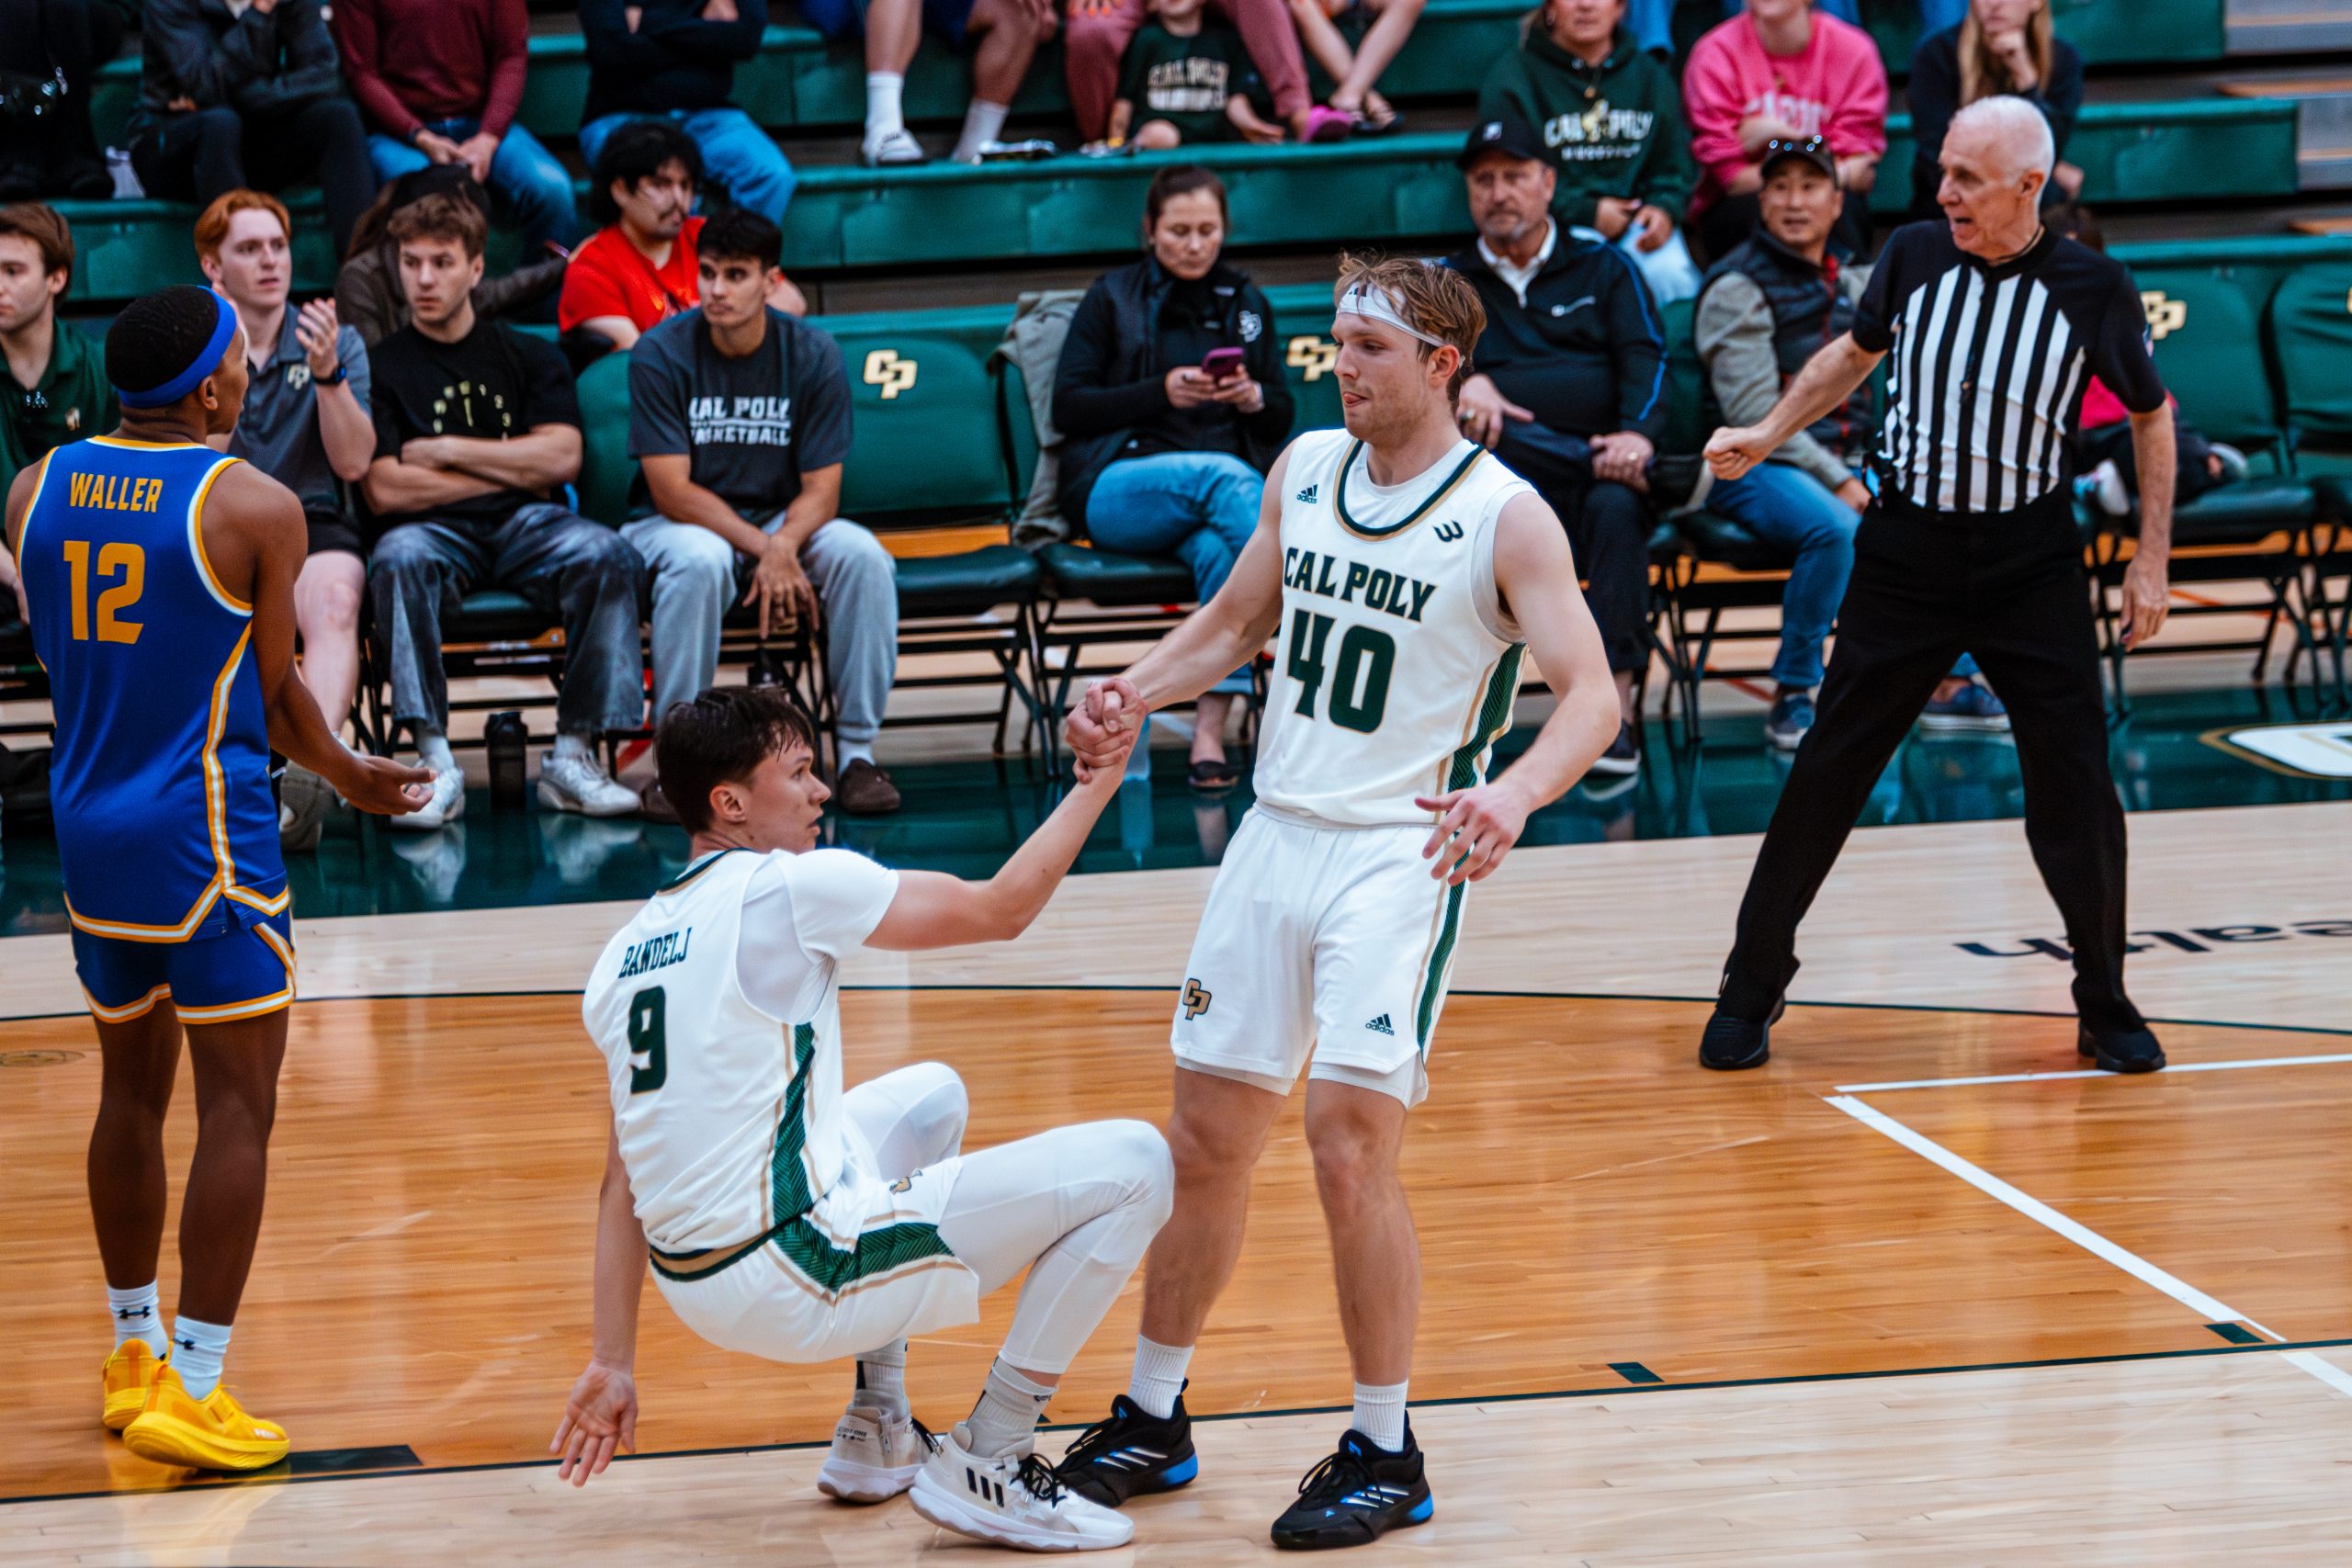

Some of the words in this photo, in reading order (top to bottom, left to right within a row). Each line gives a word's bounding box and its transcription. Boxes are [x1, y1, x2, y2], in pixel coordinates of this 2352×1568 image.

[863, 349, 918, 400] CP
[733, 396, 790, 420] POLY
[70, 471, 164, 513] WALLER
[62, 539, 146, 644] 12
[1283, 547, 1338, 598] CAL
[1340, 561, 1439, 624] POLY
[1287, 607, 1397, 736] 40
[617, 926, 693, 979] BANDELJ
[627, 985, 668, 1096] 9
[1365, 1021, 1395, 1036] adidas
